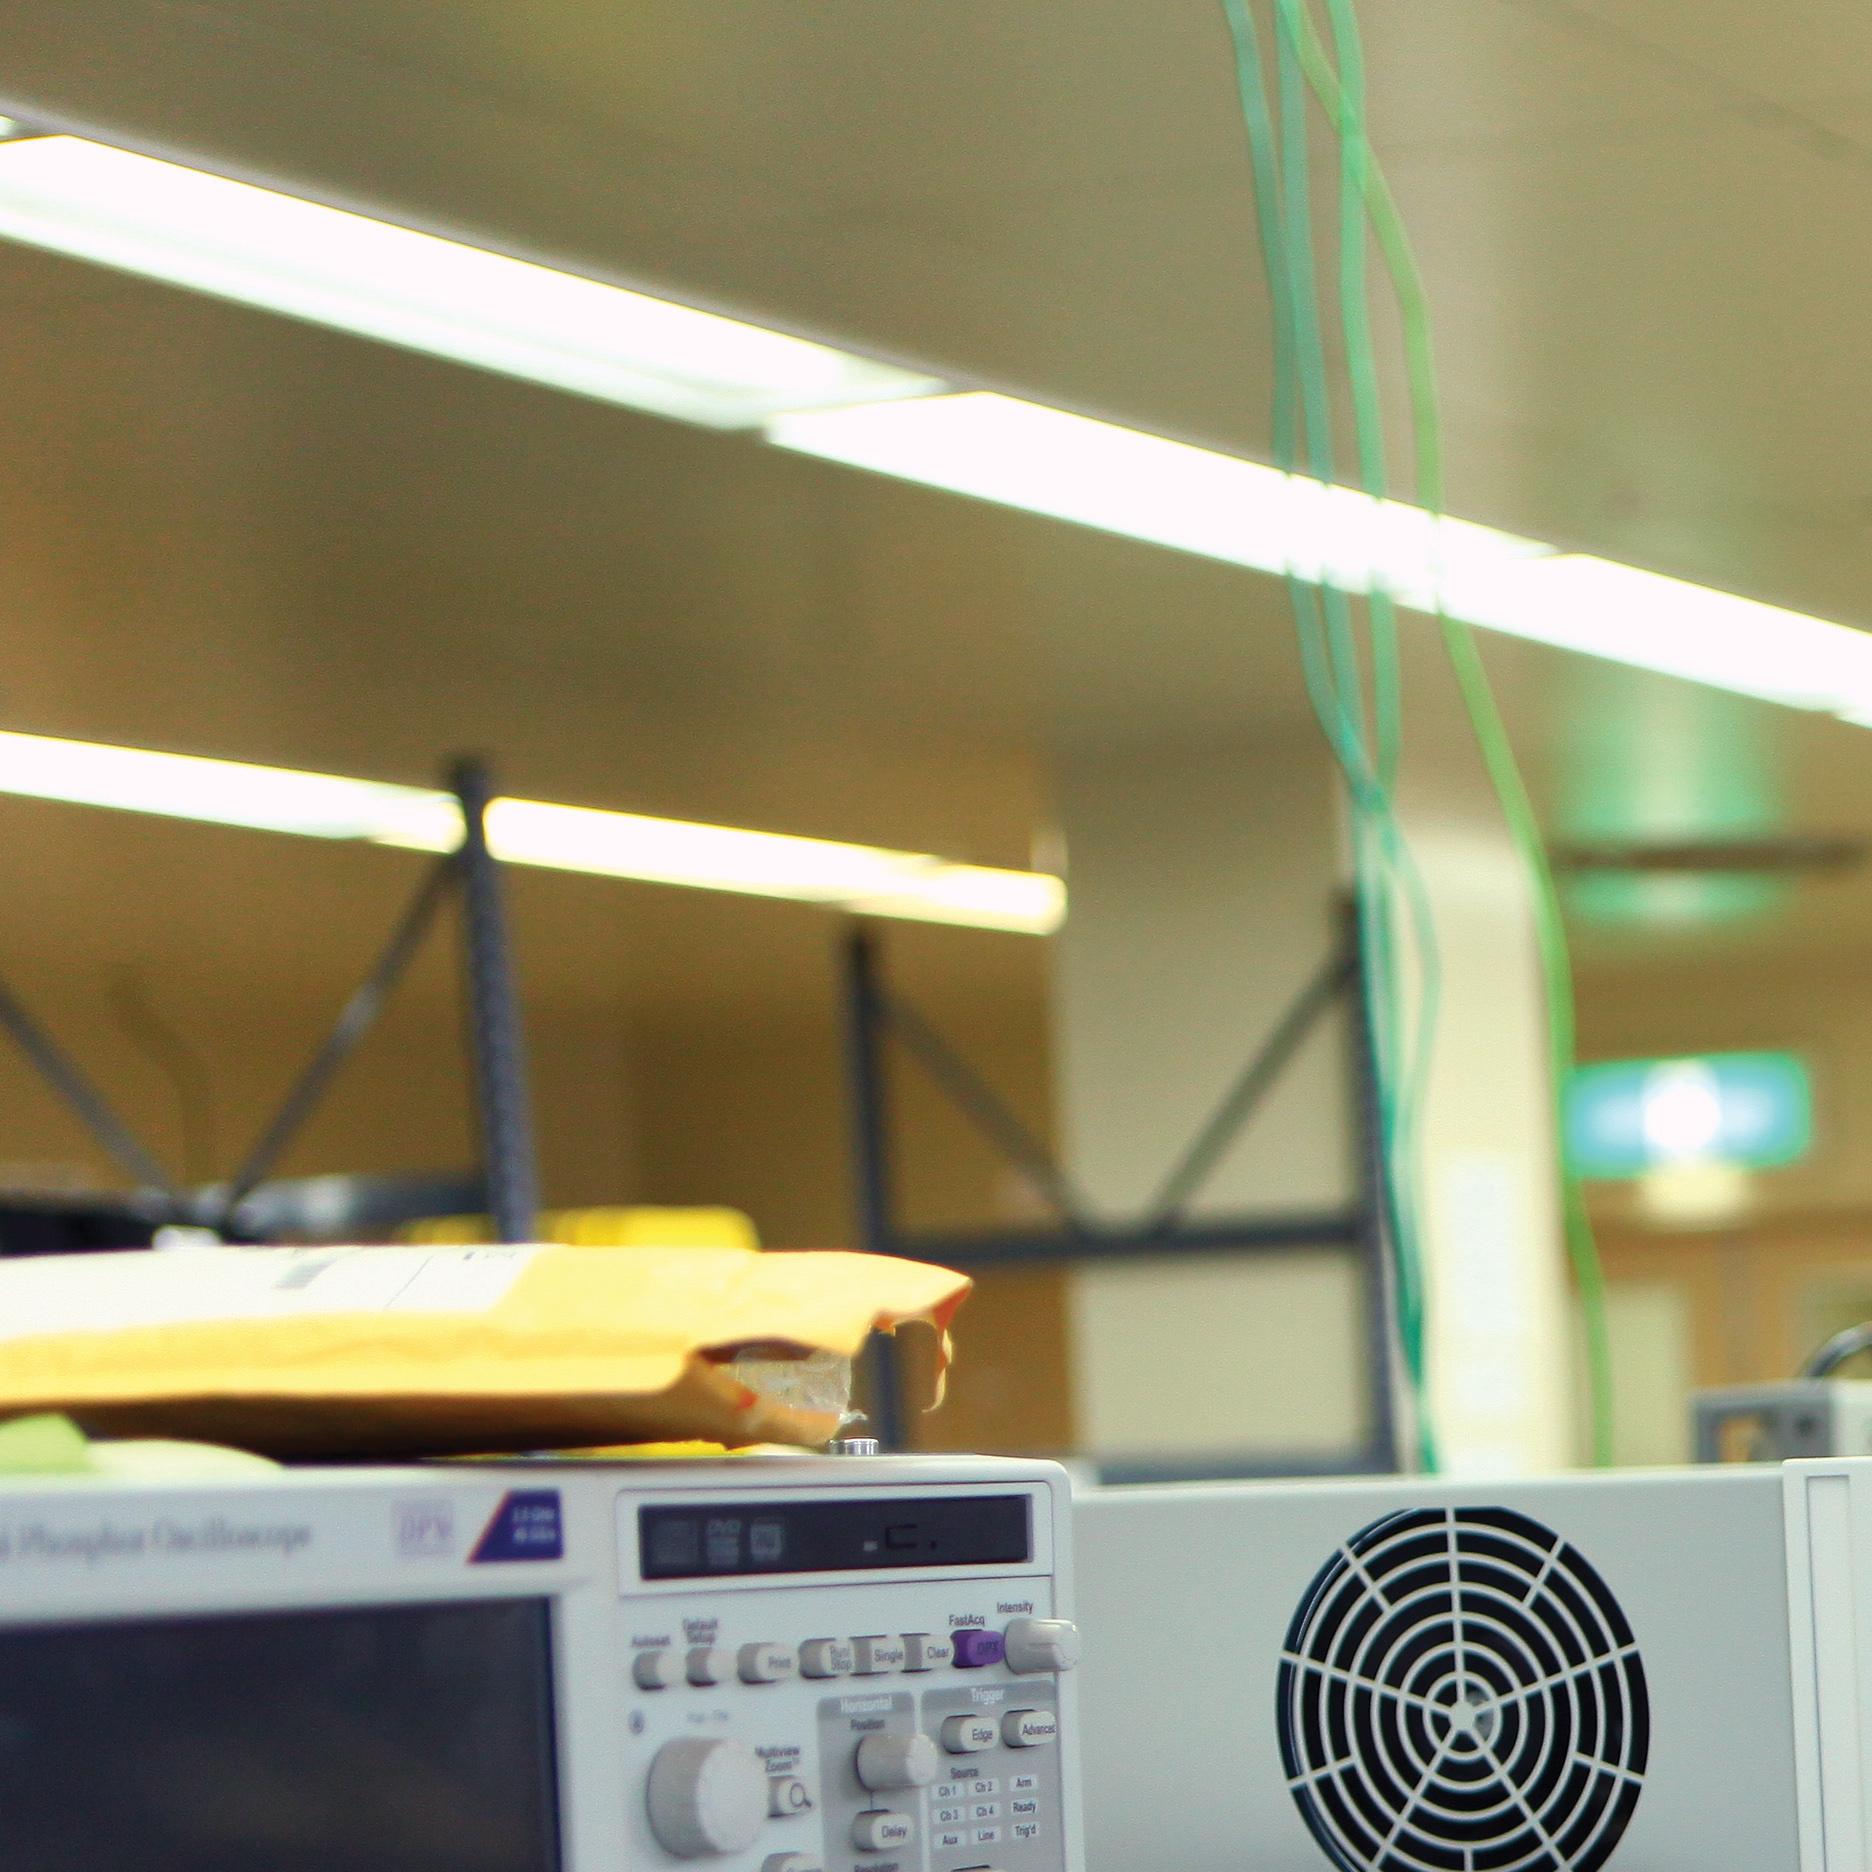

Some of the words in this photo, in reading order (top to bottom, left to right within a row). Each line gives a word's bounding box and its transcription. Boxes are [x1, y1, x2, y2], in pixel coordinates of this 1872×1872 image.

[996, 1601, 1034, 1615] Intensity
[949, 1614, 985, 1627] FastAcq
[874, 1649, 904, 1664] Single
[927, 1646, 950, 1659] Clear
[970, 1687, 1004, 1705] Trigger
[972, 1728, 994, 1742] Edge
[1022, 1721, 1056, 1736] Advanced
[950, 1766, 979, 1779] Source
[1016, 1777, 1031, 1788] Arm
[1013, 1801, 1036, 1815] Ready
[881, 1824, 907, 1839] Delay
[978, 1830, 995, 1841] Line
[943, 1835, 958, 1846] Aux
